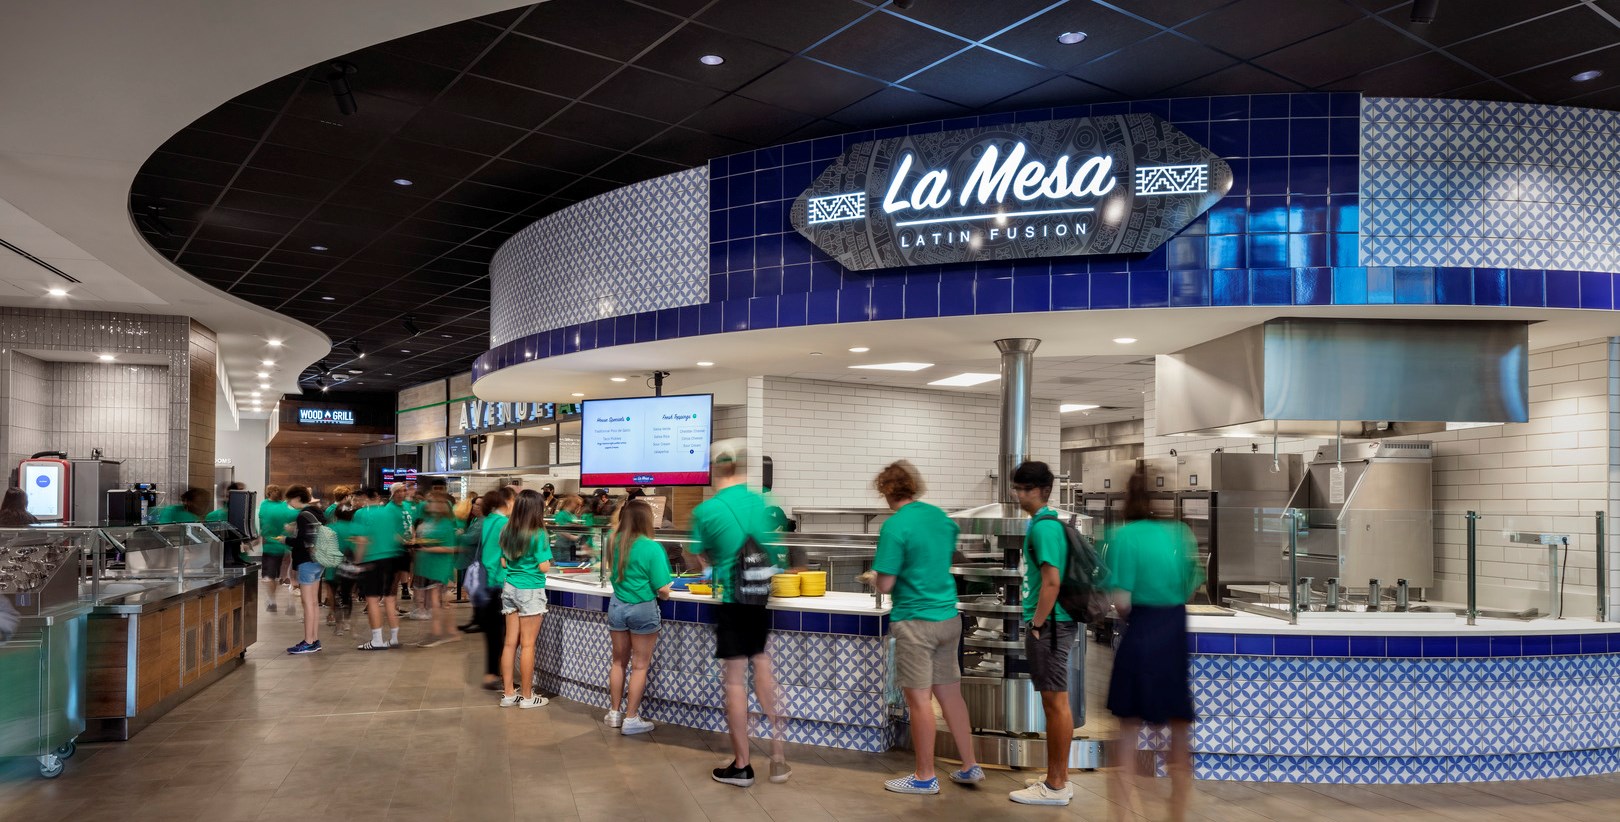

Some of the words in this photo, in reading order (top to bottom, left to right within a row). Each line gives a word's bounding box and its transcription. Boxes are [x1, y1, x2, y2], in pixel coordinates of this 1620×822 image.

[882, 153, 952, 214] La
[959, 141, 1117, 207] Mesa
[901, 230, 971, 248] LATIN
[990, 222, 1087, 241] FUSION
[300, 409, 323, 420] WOOD
[332, 411, 354, 421] GRILL
[459, 400, 545, 430] AVENUE
